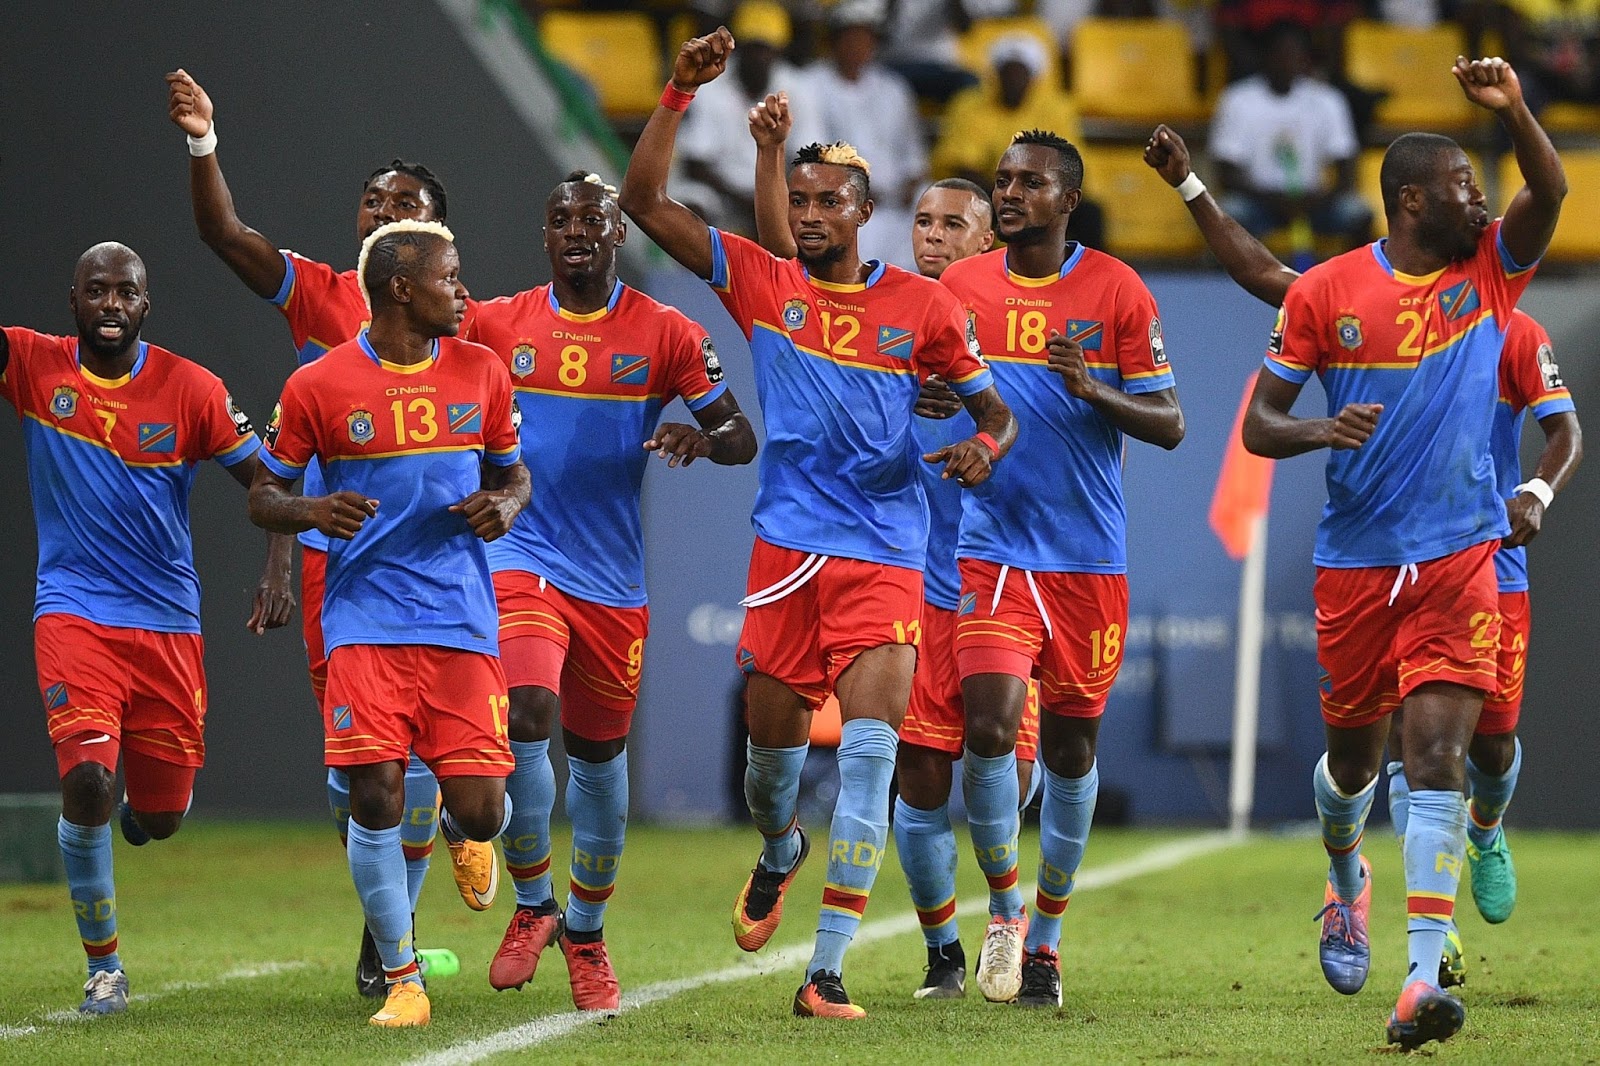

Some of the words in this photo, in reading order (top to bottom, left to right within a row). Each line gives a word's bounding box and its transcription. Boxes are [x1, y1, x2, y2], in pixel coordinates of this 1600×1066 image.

[820, 310, 861, 358] 12
[1005, 309, 1048, 354] 18
[558, 344, 589, 388] 8
[93, 408, 117, 444] 7
[390, 397, 439, 446] 13
[1089, 623, 1121, 669] 18
